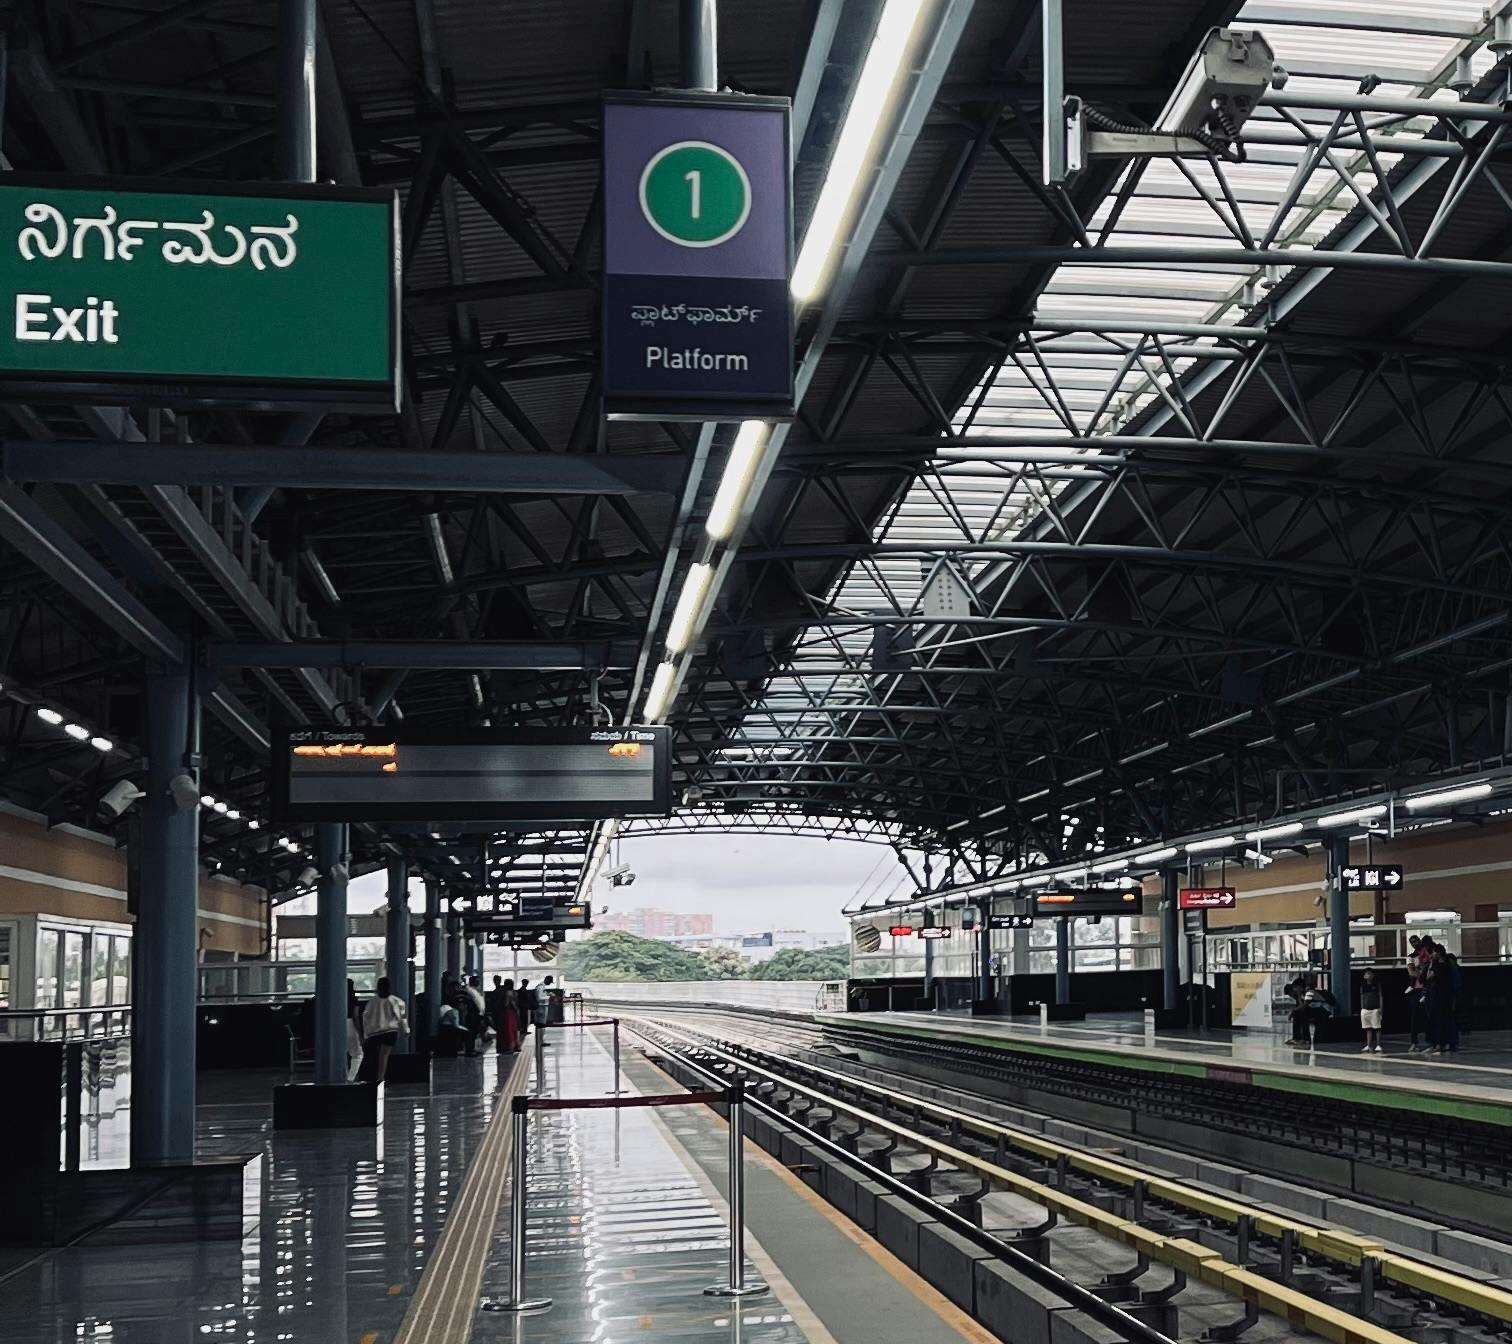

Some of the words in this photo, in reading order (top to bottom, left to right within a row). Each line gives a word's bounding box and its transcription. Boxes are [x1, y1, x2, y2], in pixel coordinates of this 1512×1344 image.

[684, 170, 701, 219] 1
[18, 203, 299, 270] ನಿರ್ಗಮನ
[15, 294, 119, 343] Exit
[646, 346, 749, 370] Platform
